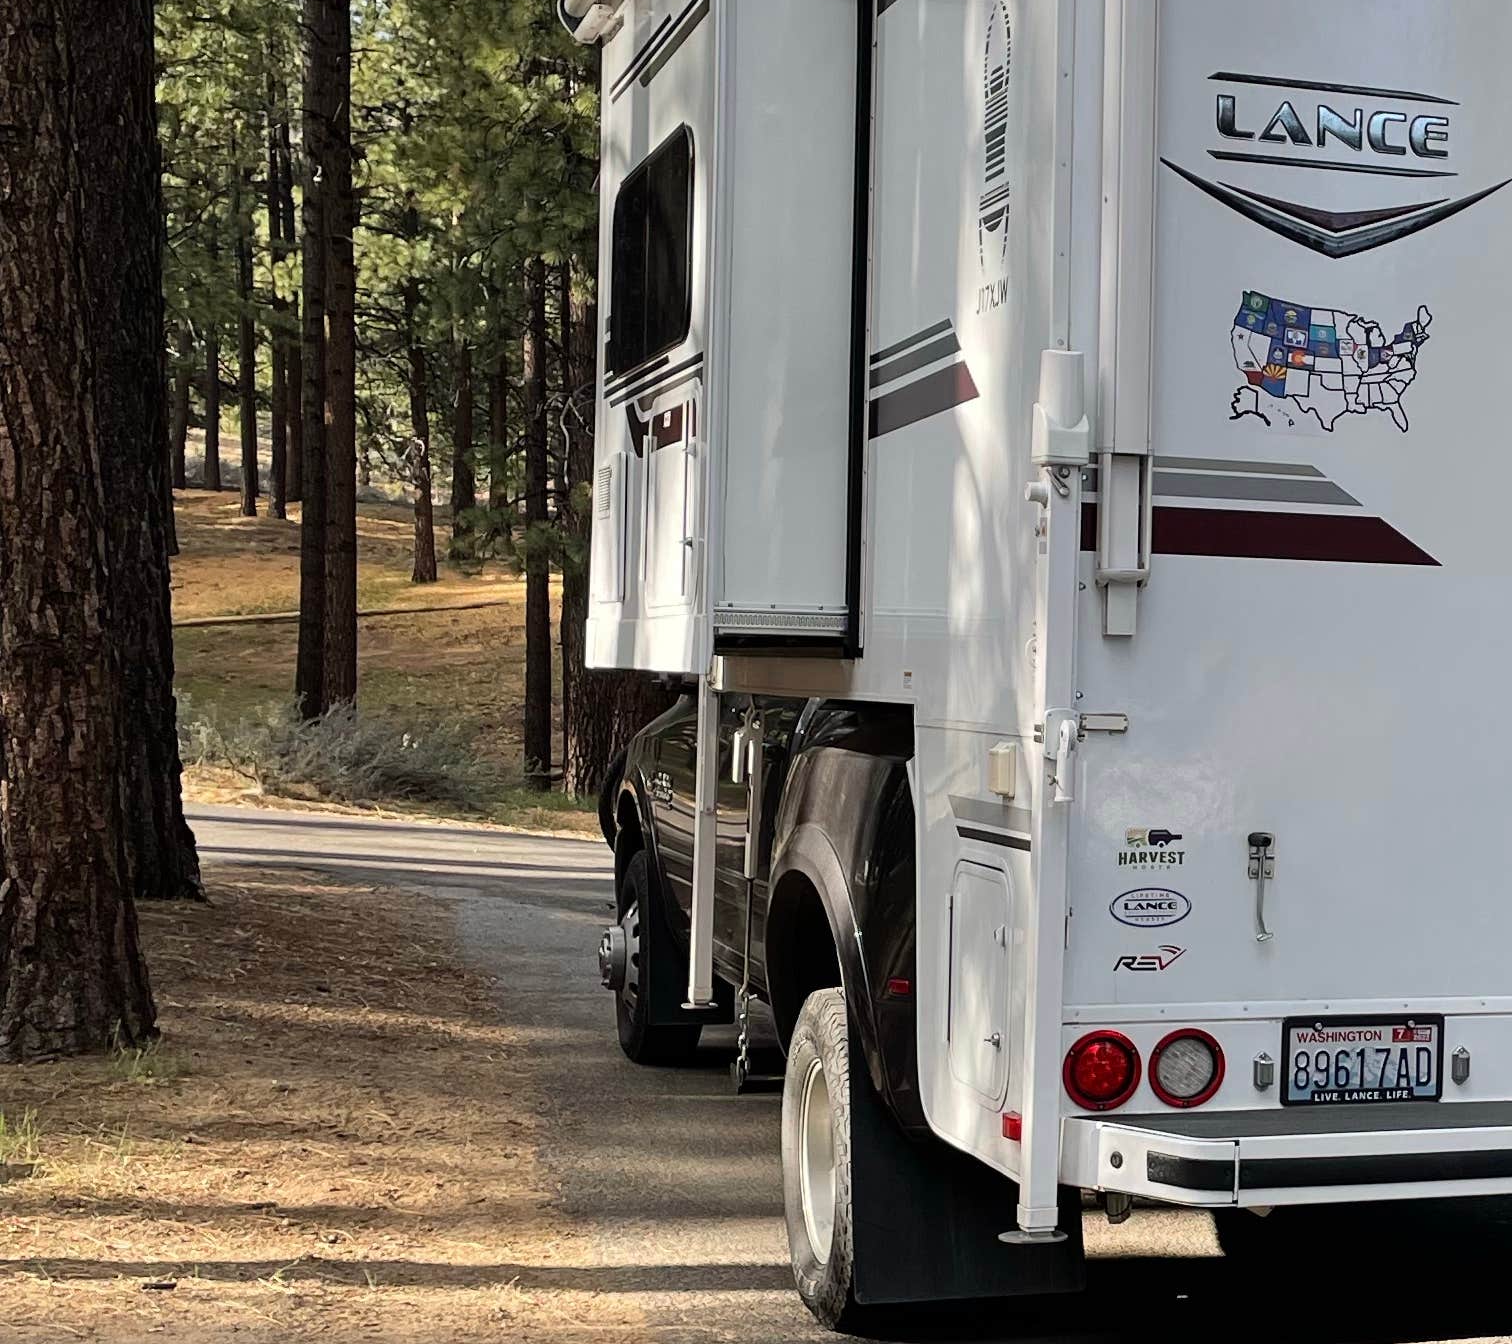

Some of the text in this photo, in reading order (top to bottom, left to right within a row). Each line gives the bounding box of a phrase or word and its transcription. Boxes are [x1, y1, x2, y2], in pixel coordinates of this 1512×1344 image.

[1216, 94, 1449, 158] LANCE
[1118, 851, 1185, 865] HARVEST
[1123, 901, 1177, 911] LANCE
[1113, 946, 1187, 972] REV
[1296, 1030, 1382, 1044] WASHINGTON
[1294, 1046, 1432, 1090] 89617AD
[1314, 1089, 1411, 1102] LIVE. LANCE. LIFE.
